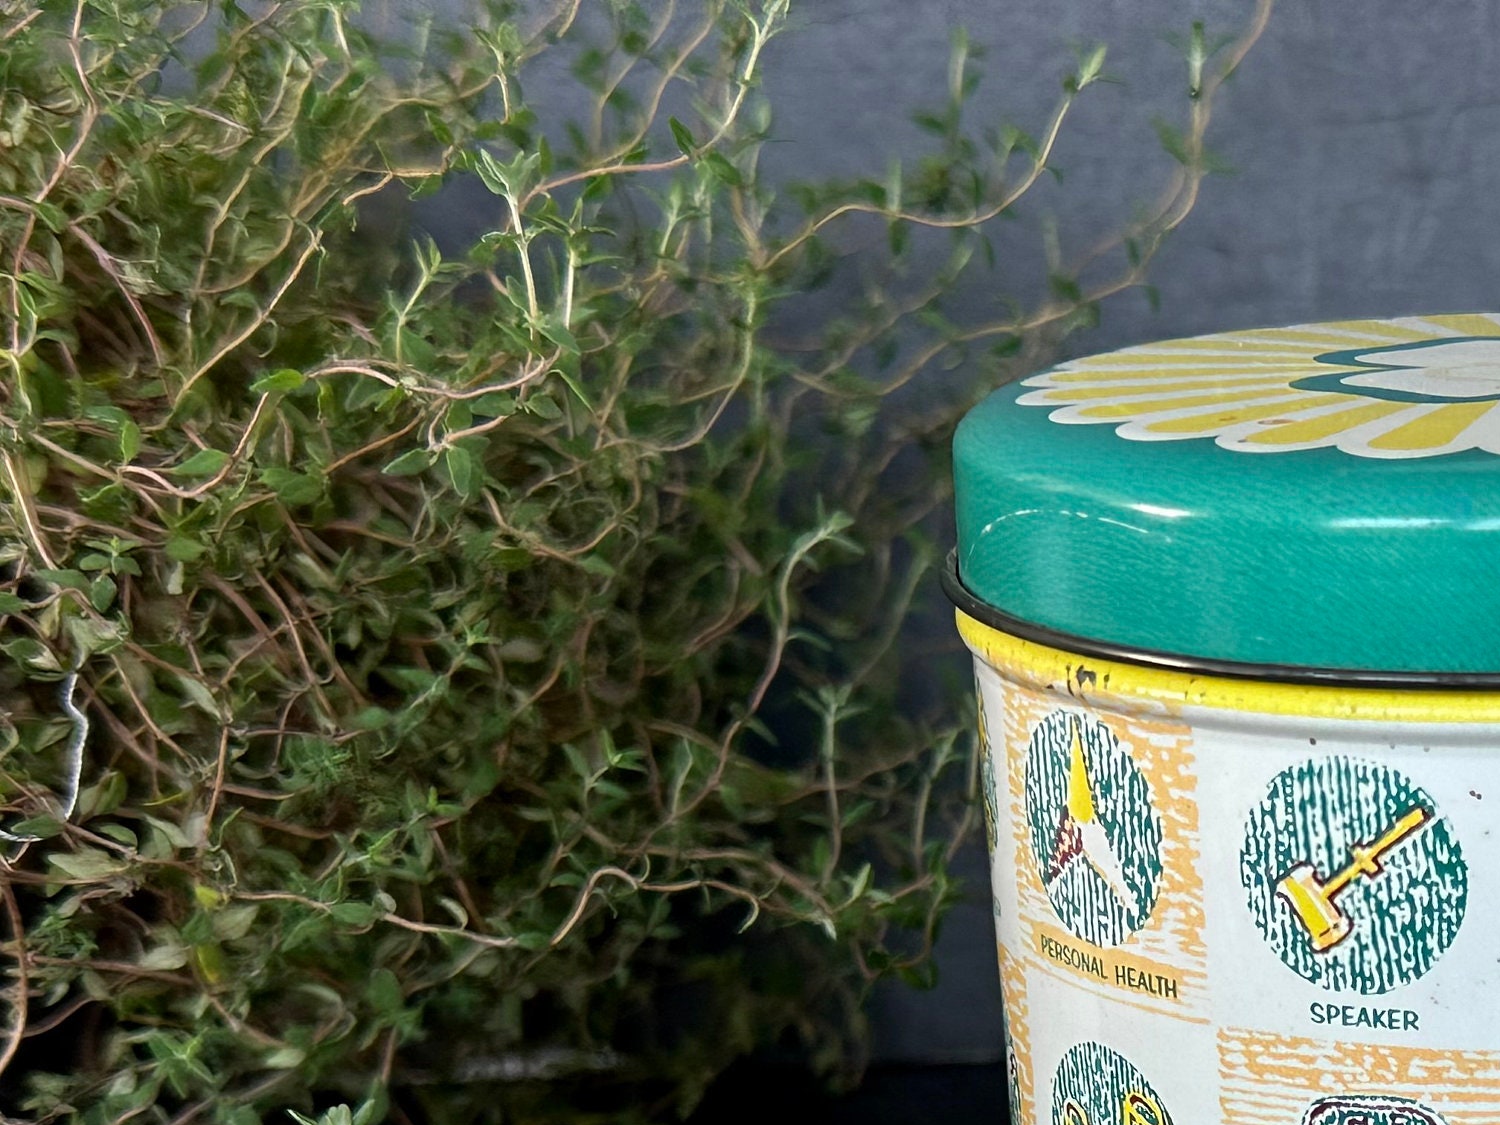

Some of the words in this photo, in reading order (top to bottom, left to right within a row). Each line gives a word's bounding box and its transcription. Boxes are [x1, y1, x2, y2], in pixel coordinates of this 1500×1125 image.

[1041, 934, 1108, 980] PERSONAL
[1115, 965, 1178, 999] HEALTH
[1310, 1003, 1420, 1032] SPEAKER
